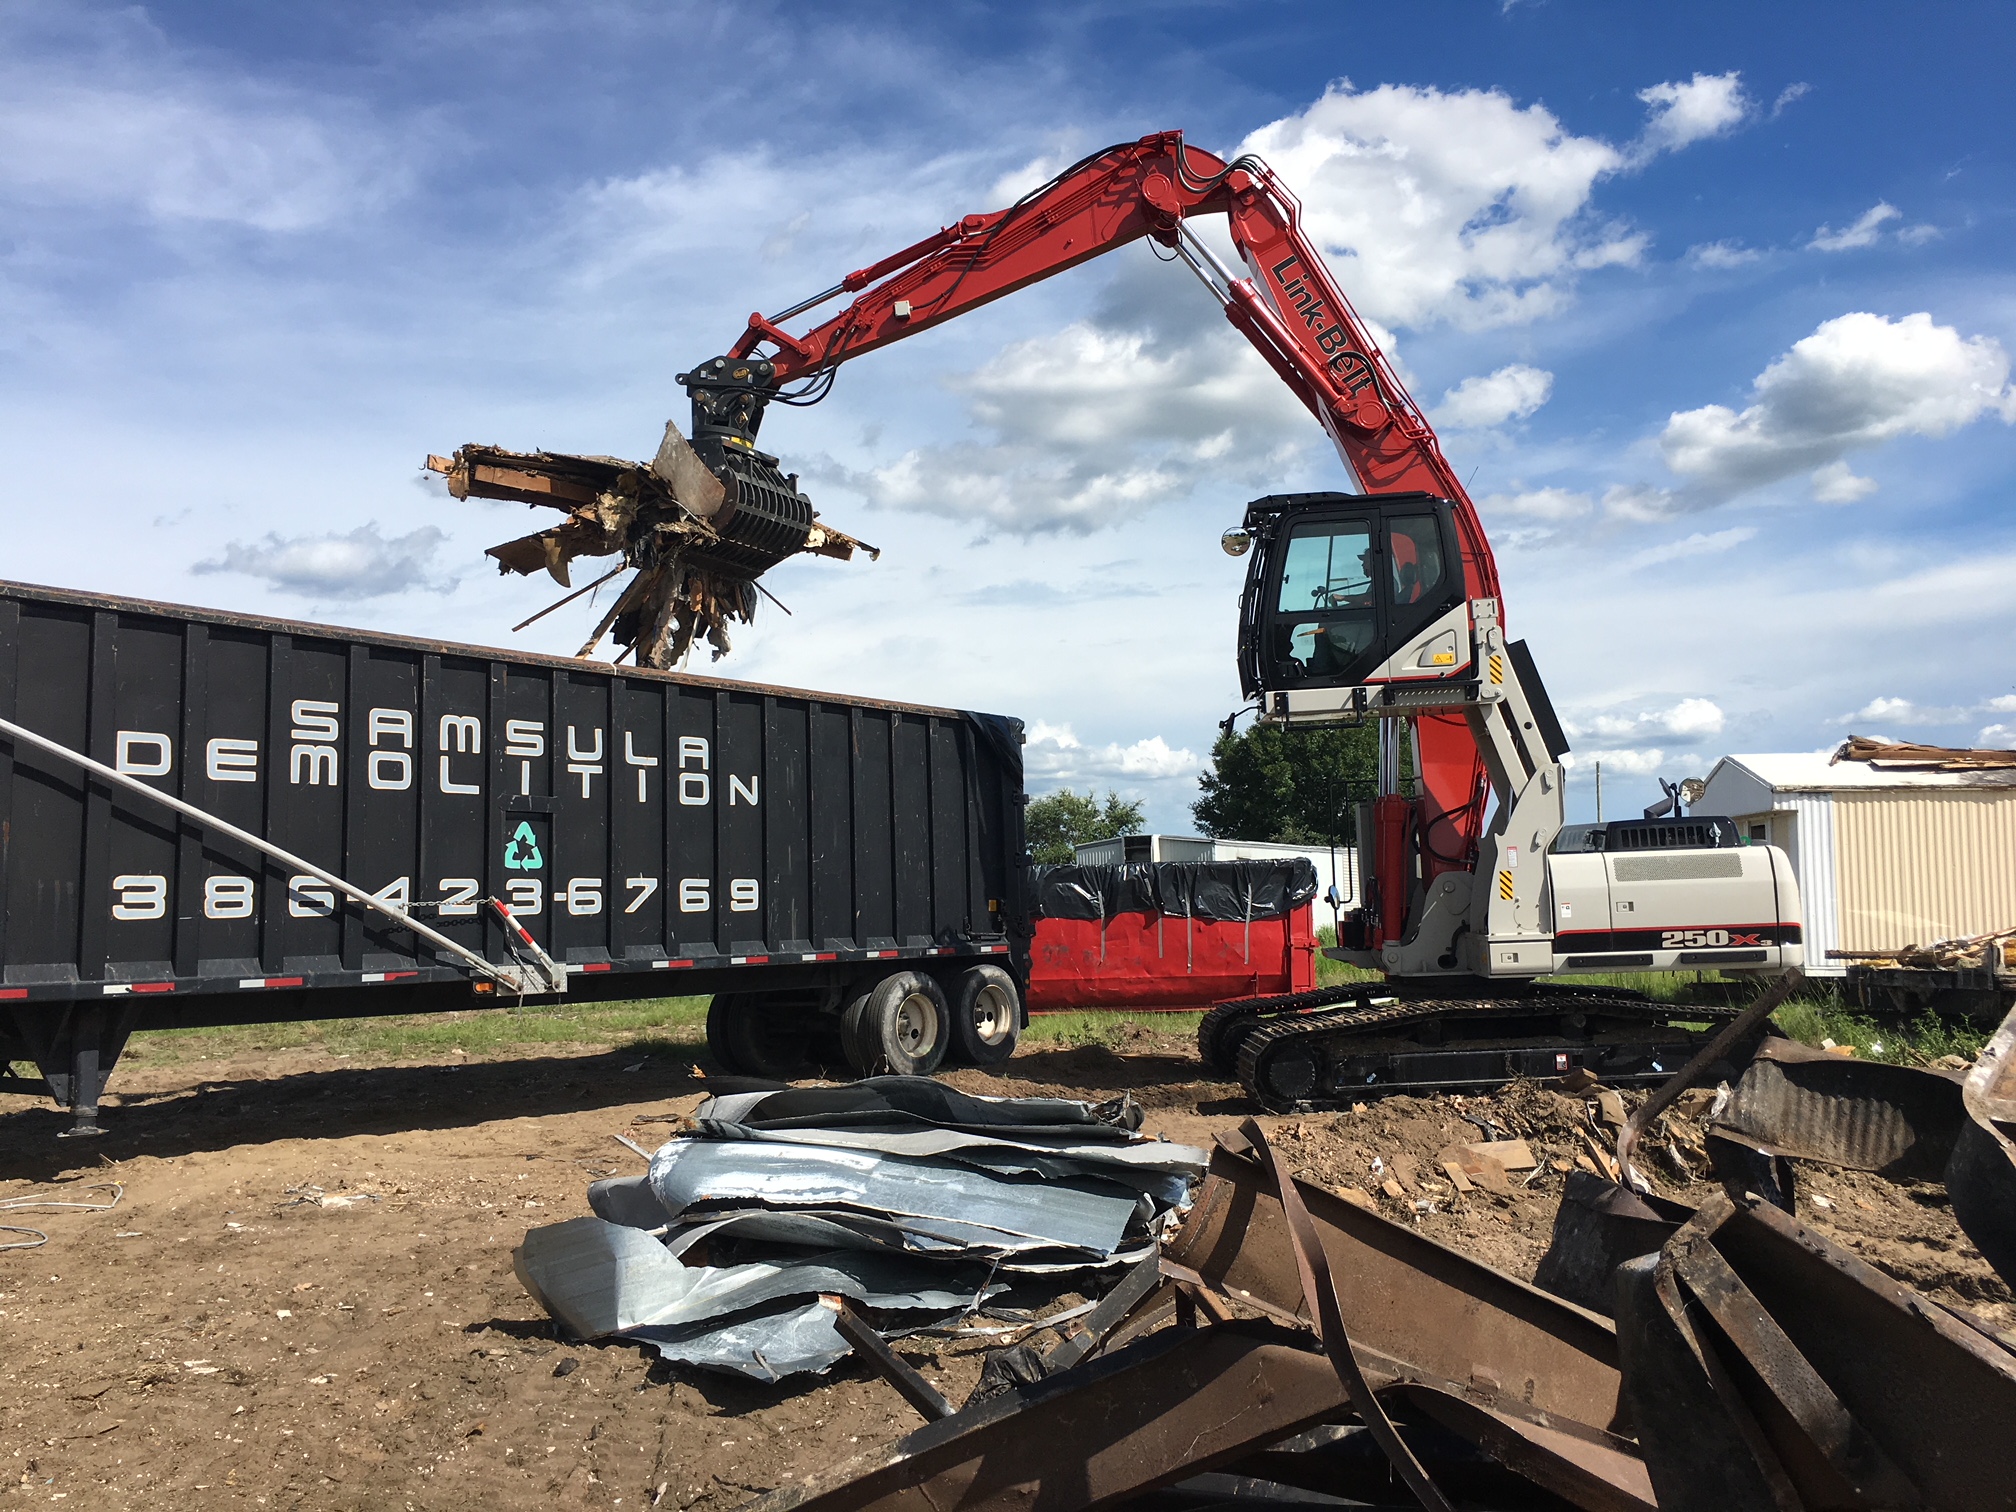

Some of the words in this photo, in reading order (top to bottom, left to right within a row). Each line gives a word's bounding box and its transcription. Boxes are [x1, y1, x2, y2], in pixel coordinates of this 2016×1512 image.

[1271, 254, 1373, 397] Link-Belt
[116, 730, 758, 806] DEMOLITION
[291, 699, 709, 770] SAMSULA
